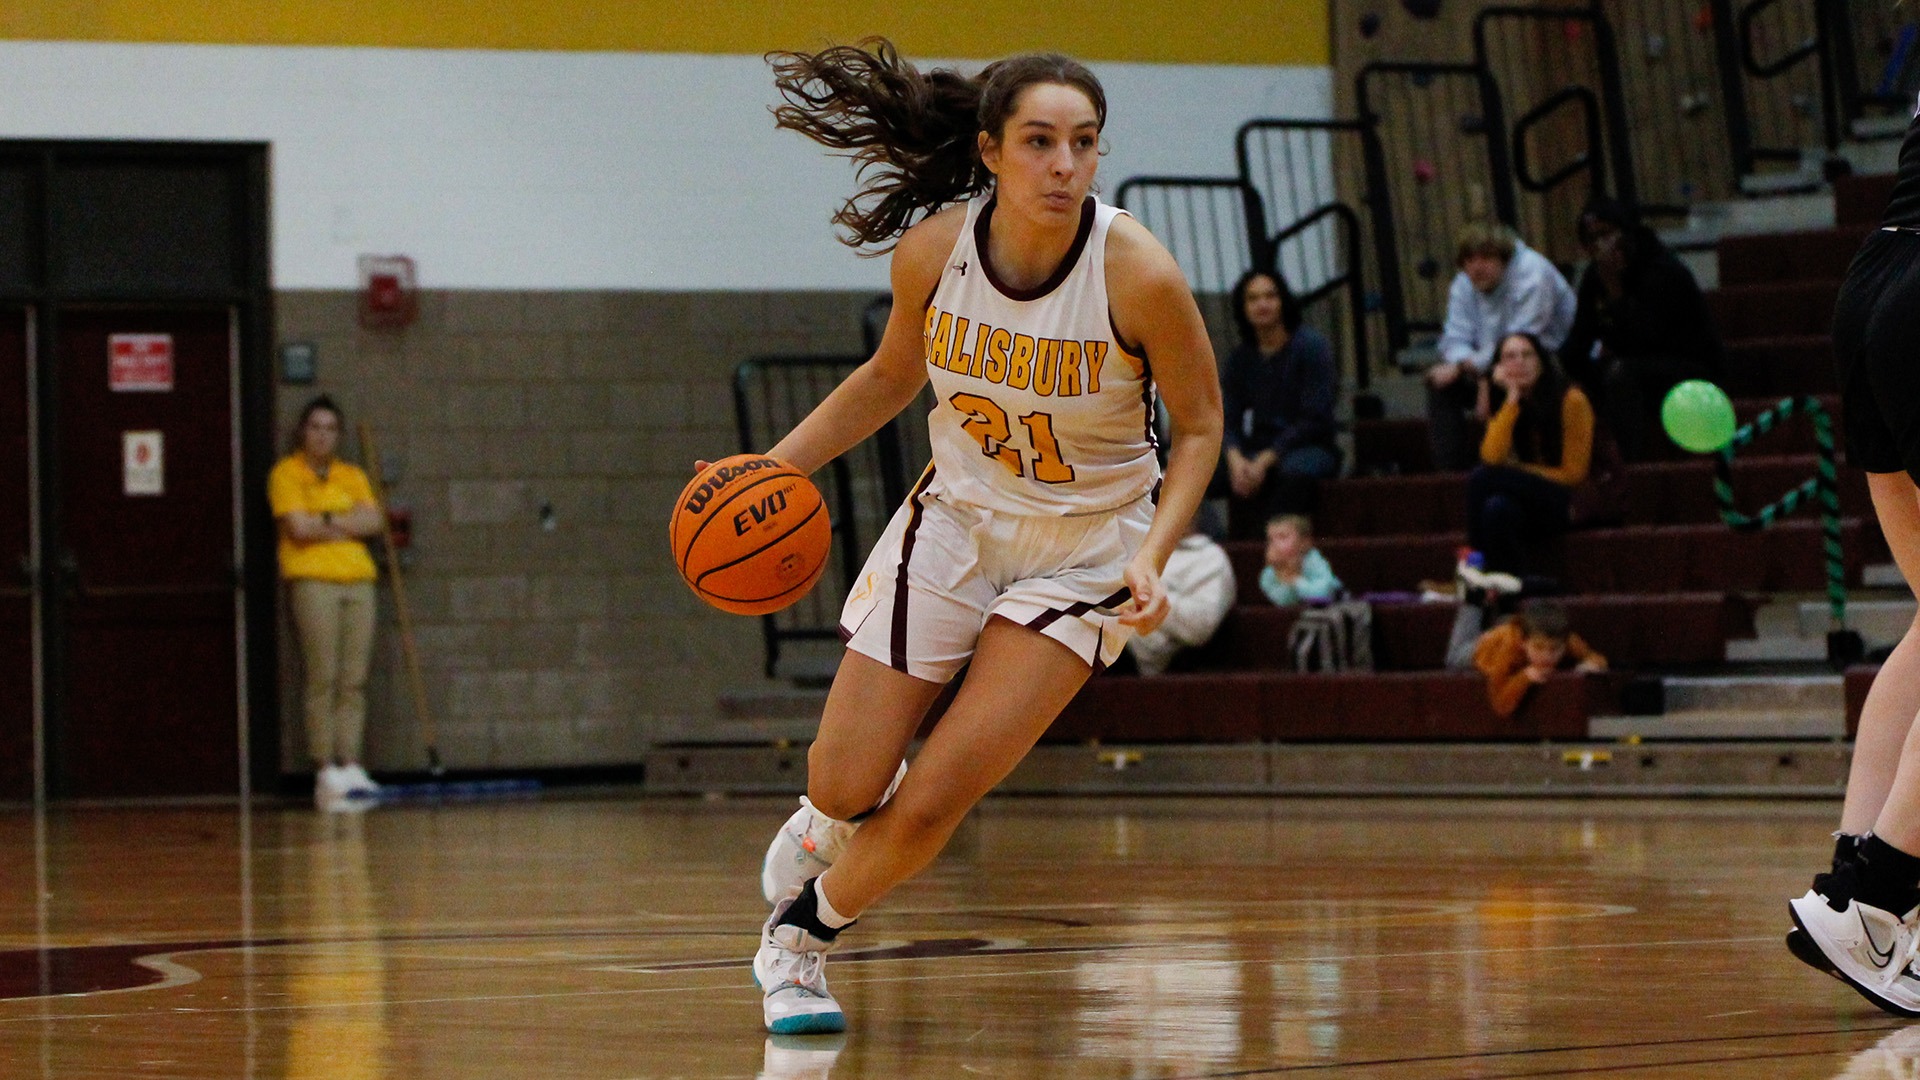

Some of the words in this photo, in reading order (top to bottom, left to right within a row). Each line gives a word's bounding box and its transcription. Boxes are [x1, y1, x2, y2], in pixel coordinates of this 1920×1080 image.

[949, 391, 1076, 485] 21
[684, 459, 783, 515] Wilson
[733, 489, 787, 537] EVO
[783, 483, 798, 495] NXT
